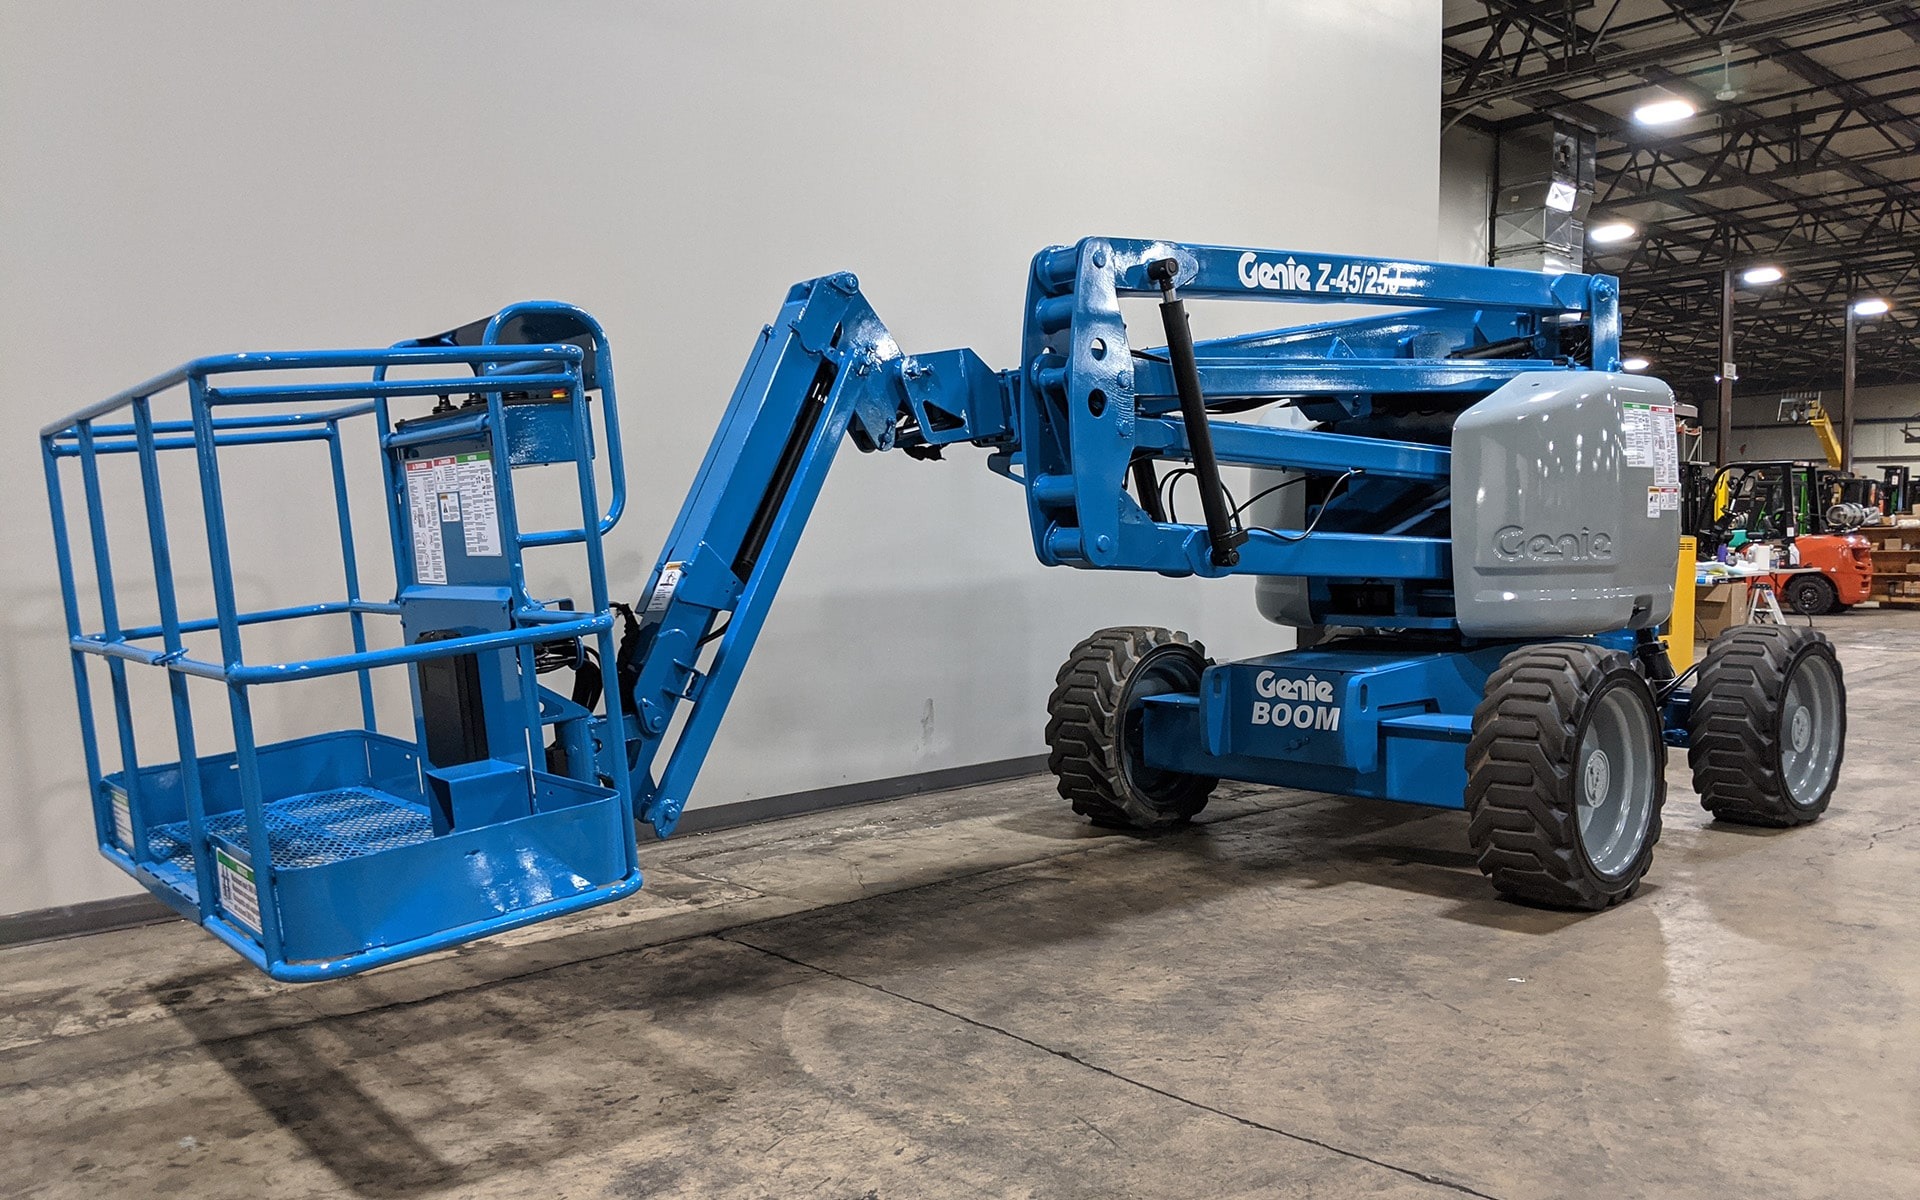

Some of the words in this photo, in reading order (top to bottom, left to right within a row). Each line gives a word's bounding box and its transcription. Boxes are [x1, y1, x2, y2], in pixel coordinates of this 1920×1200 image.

[1238, 252, 1311, 291] Genie
[1493, 525, 1612, 561] Genie
[1256, 670, 1333, 703] Genie
[1251, 701, 1340, 731] BOOM
